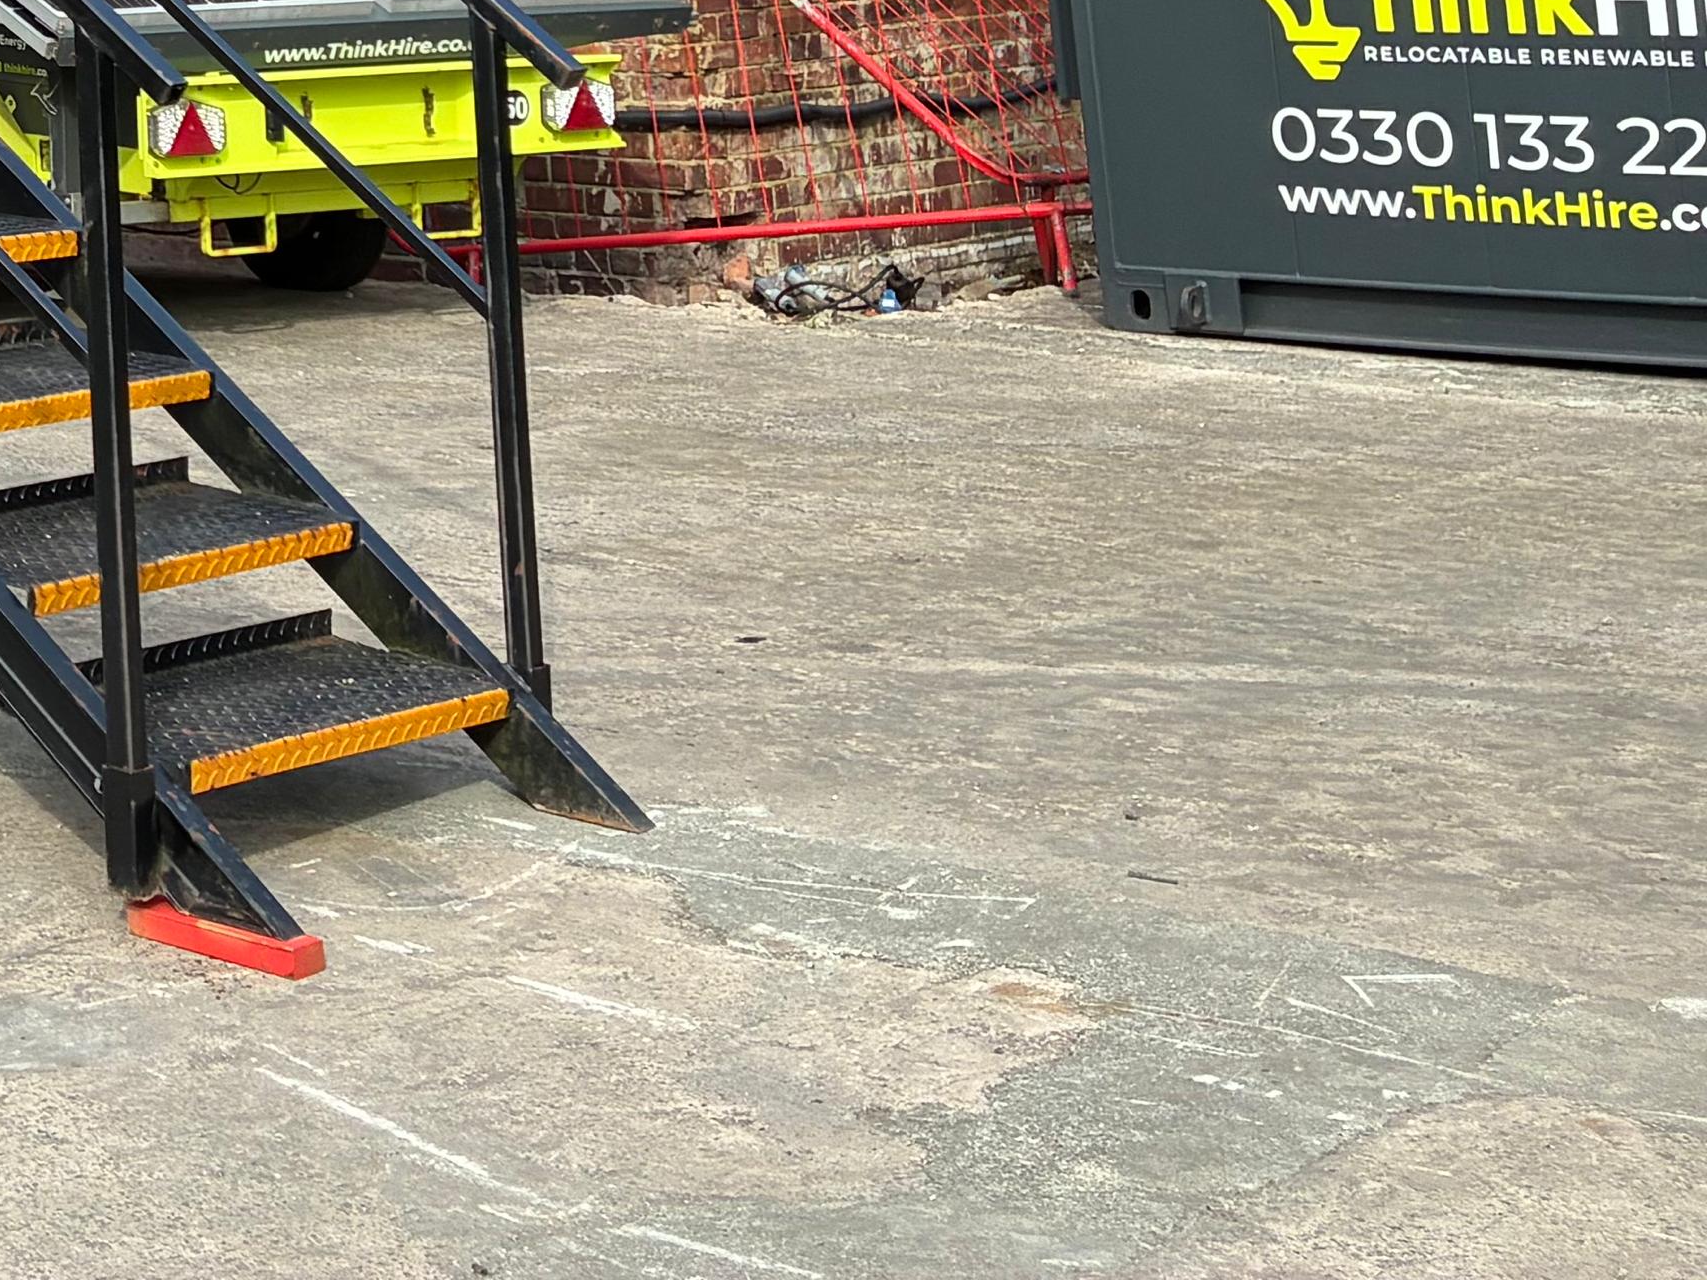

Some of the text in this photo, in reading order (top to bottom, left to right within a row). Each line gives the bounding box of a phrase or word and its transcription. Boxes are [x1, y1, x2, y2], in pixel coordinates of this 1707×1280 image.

[264, 36, 473, 64] www.ThinkHire.co.
[1363, 45, 1532, 65] RELOCATABLE
[1540, 48, 1696, 68] RENEWABLE
[1271, 106, 1707, 176] 0330 133 22
[1278, 184, 1707, 233] www.ThinkHire.c
